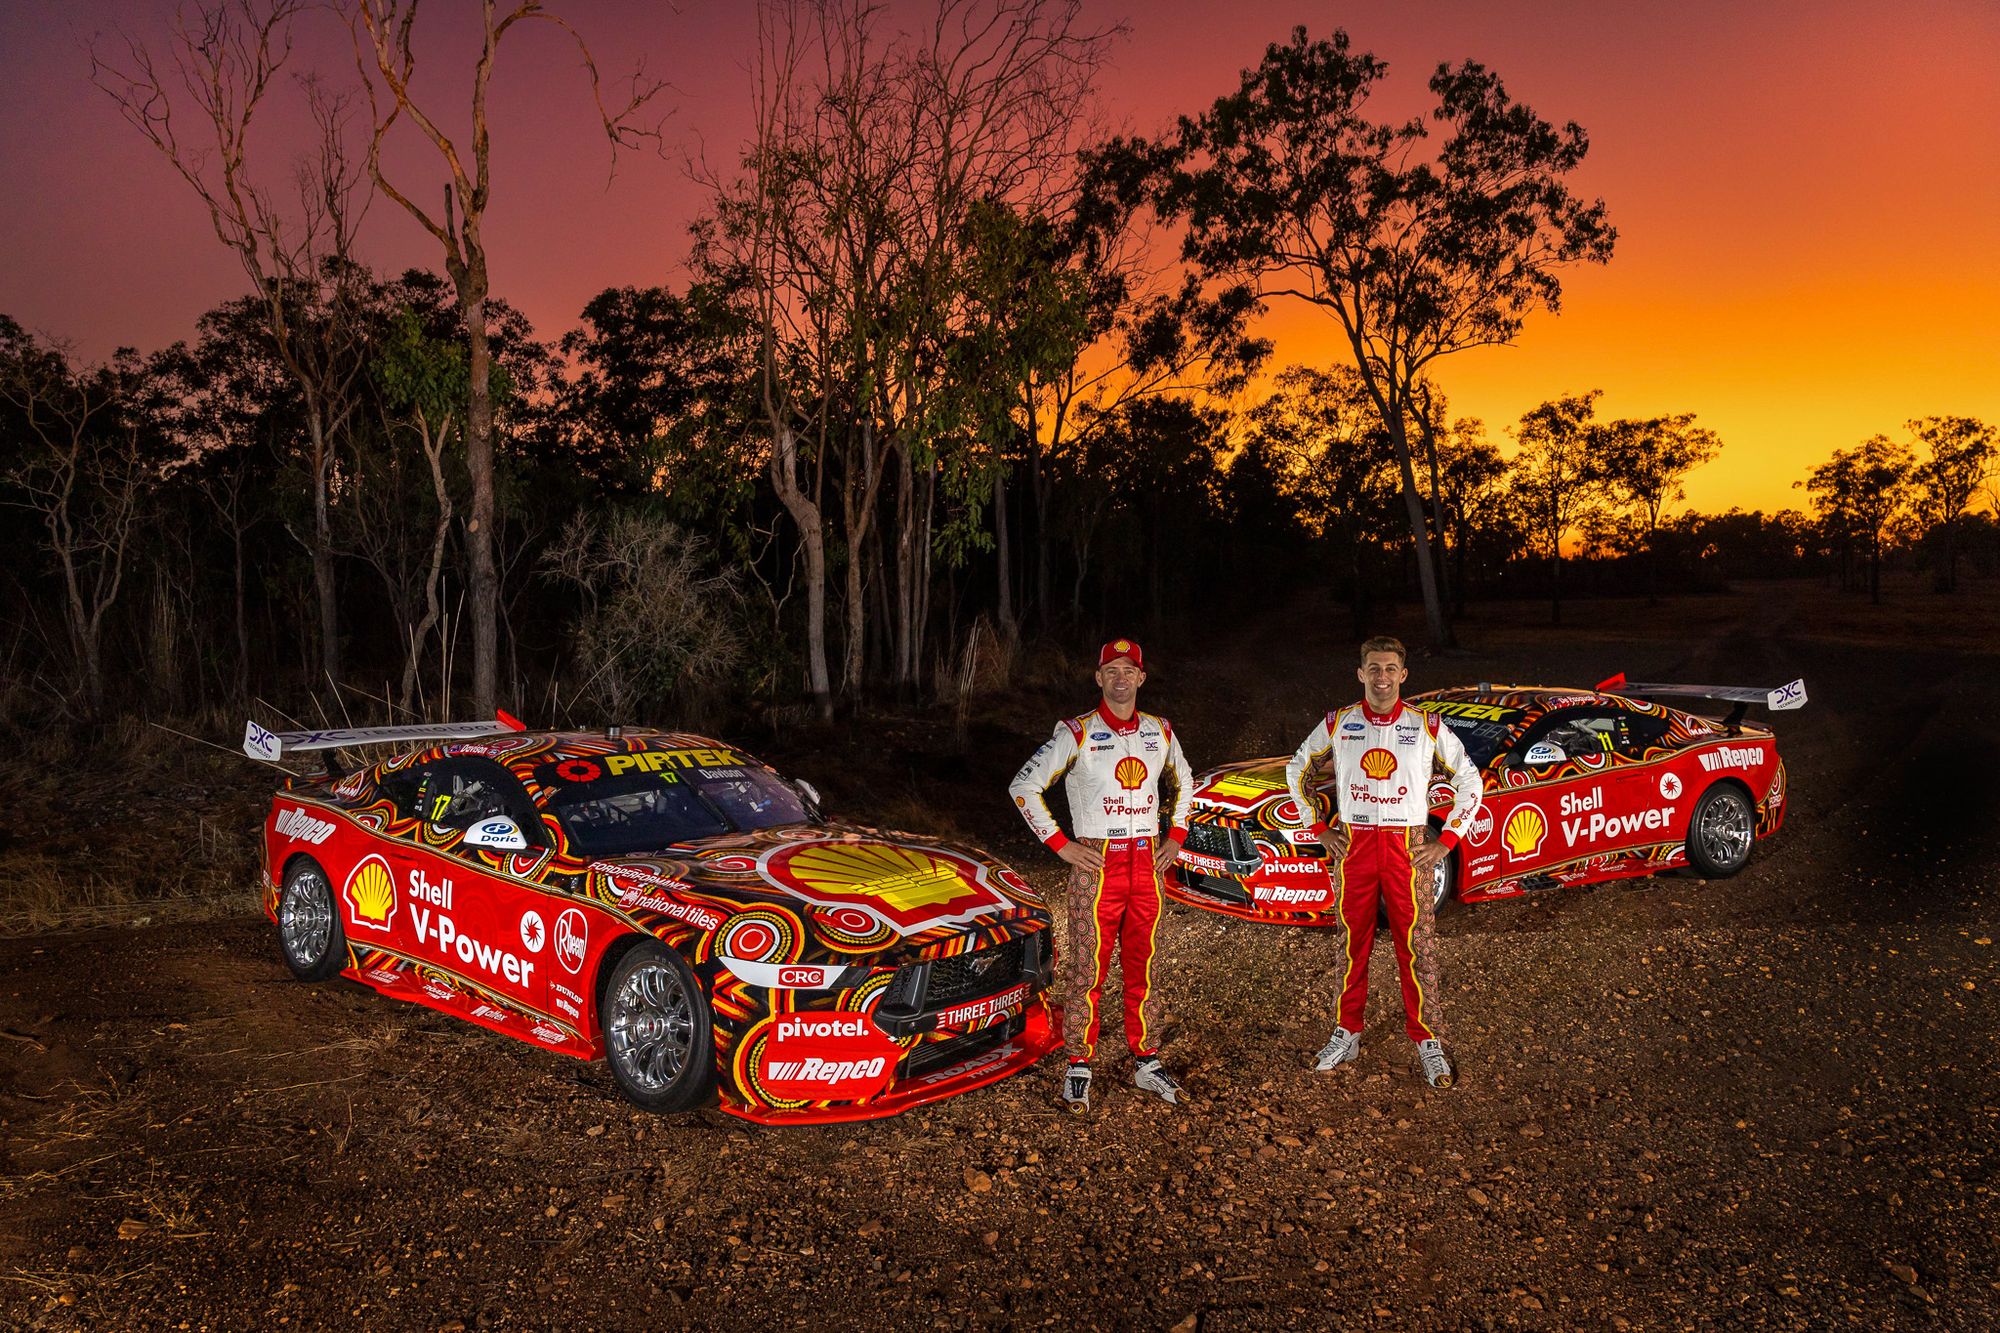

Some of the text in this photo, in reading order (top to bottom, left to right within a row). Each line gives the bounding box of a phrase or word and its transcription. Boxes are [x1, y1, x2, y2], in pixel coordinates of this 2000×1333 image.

[1774, 681, 1801, 704] DXC
[249, 723, 275, 753] DXC
[358, 724, 500, 737] TECHNOLOGY
[1345, 723, 1363, 731] Ford
[1598, 732, 1614, 751] 11
[604, 750, 747, 776] PIRTEK
[1718, 746, 1764, 771] Repco
[660, 772, 679, 784] 17
[698, 768, 746, 781] Davison
[1350, 784, 1369, 792] Shell
[1351, 791, 1403, 805] V-Power
[430, 794, 452, 821] 17
[1103, 796, 1124, 805] Shell
[1103, 805, 1151, 816] V-Power
[1560, 786, 1603, 816] Shell
[287, 806, 337, 845] Repco
[1561, 807, 1676, 848] V-Power
[481, 835, 518, 843] Doric
[1177, 850, 1221, 870] HREE THREES
[409, 869, 453, 911] Shell
[1271, 886, 1328, 904] Repco
[635, 893, 720, 932] national tiles
[409, 902, 535, 989] V-Power
[559, 911, 585, 962] Rheem
[780, 970, 822, 983] CRC
[556, 983, 584, 1005] DUNLOP
[947, 987, 1025, 1025] THREE THREES
[777, 1017, 869, 1042] pivotel.
[796, 1057, 886, 1085] Repco
[919, 1042, 1025, 1084] ROADX
[967, 1061, 1009, 1079] TYRES
